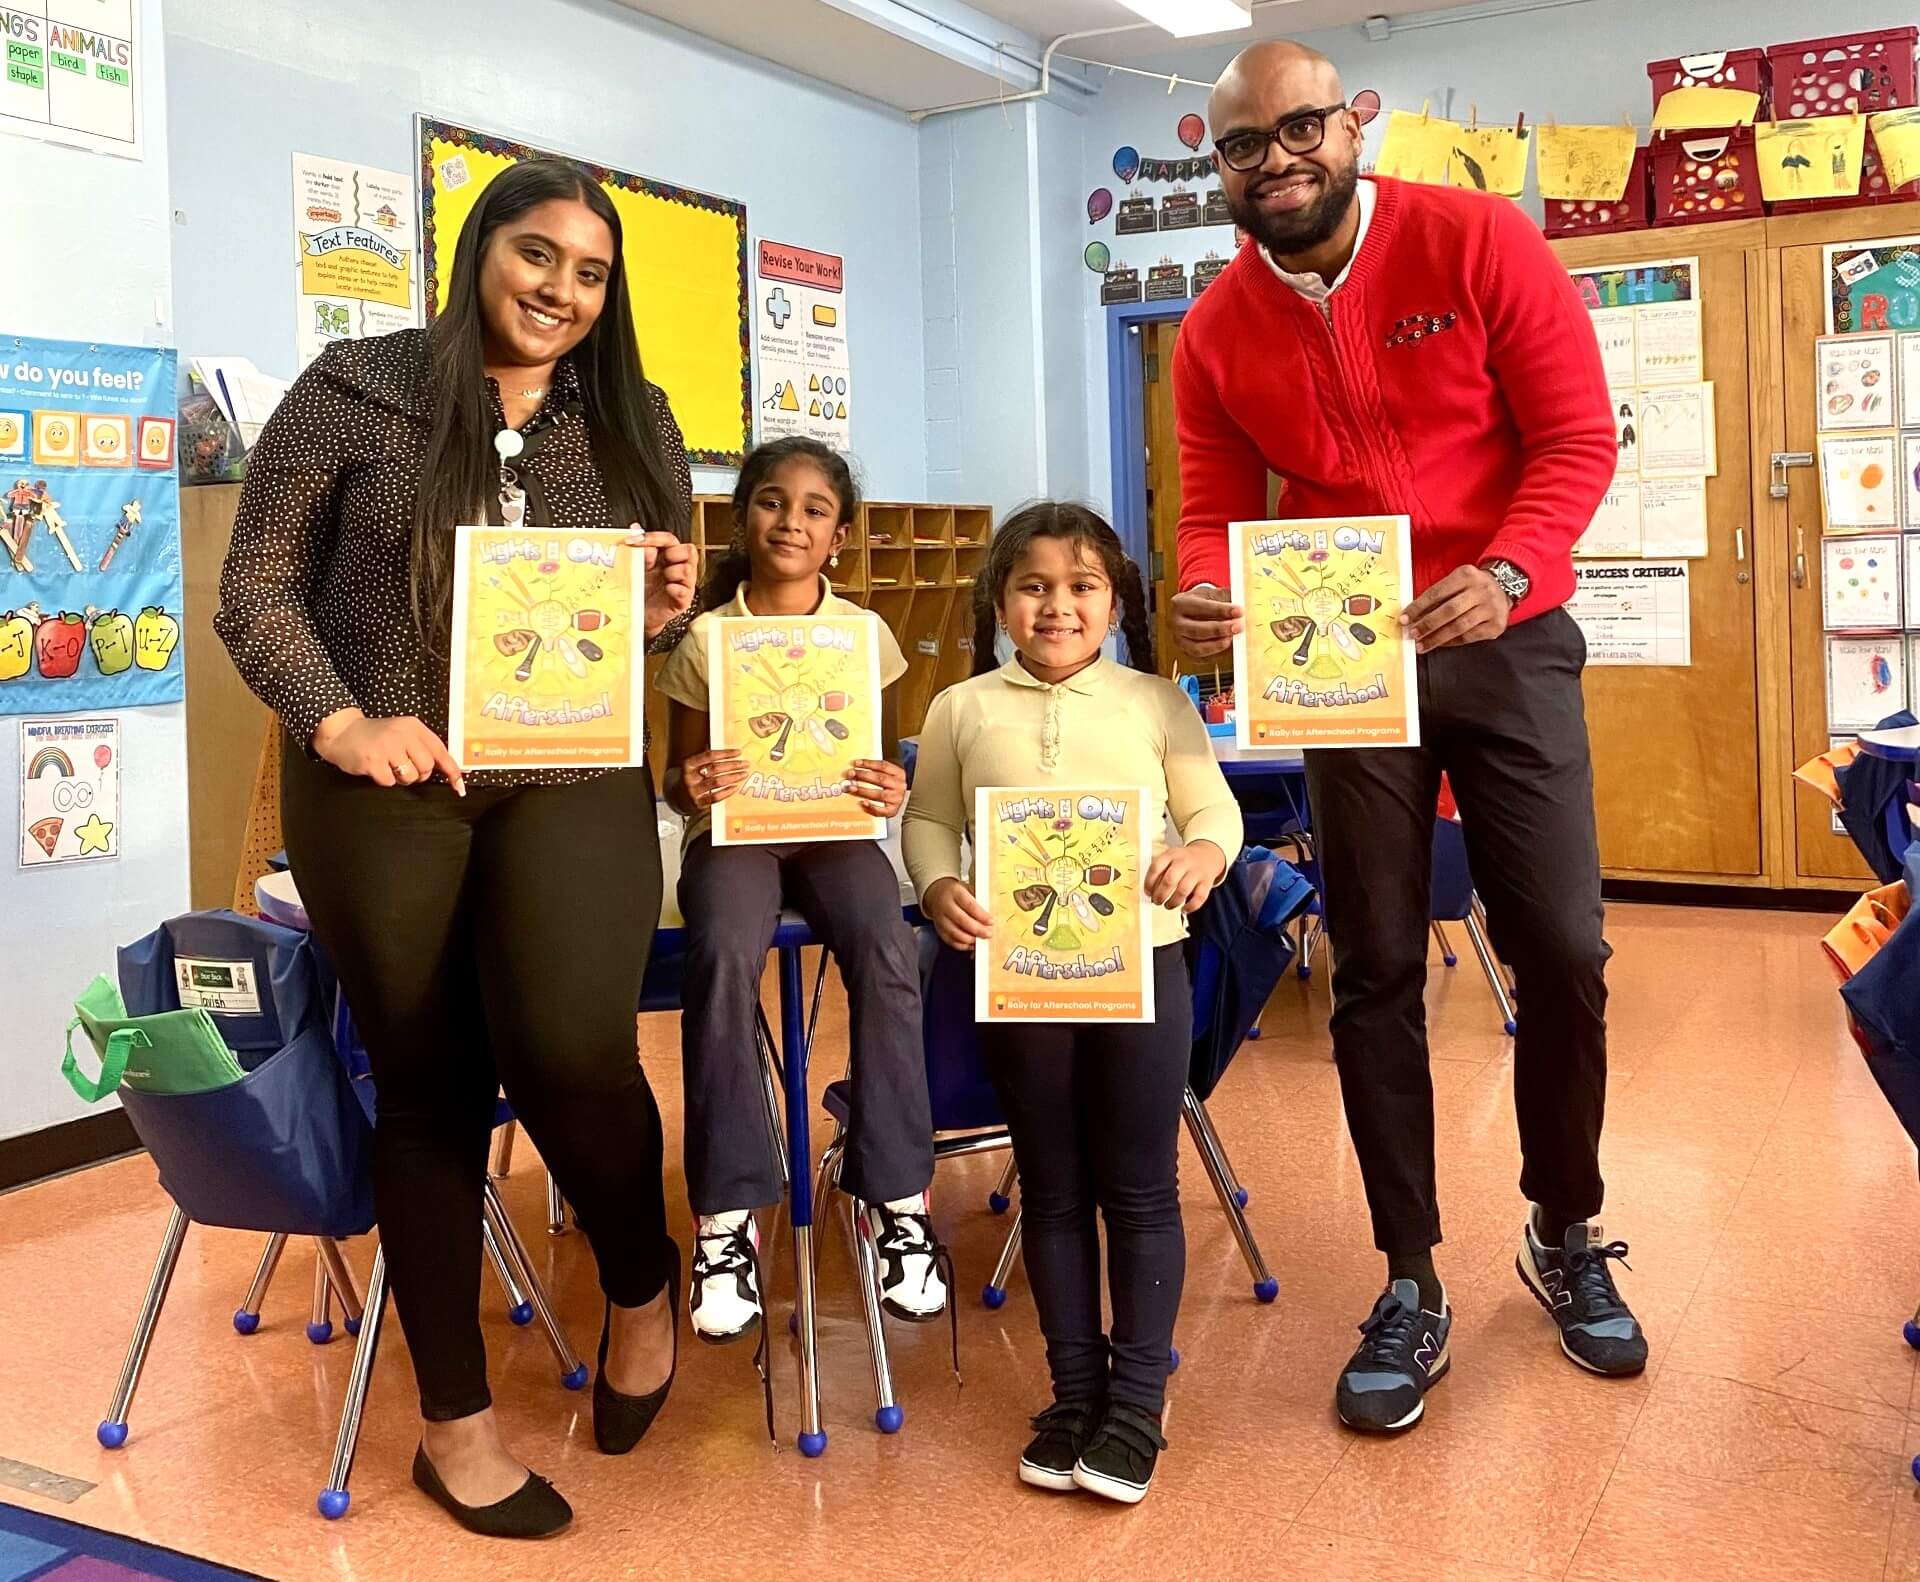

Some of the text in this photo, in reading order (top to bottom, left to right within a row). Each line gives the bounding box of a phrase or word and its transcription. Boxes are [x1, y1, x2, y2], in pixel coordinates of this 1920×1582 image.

[8, 44, 40, 61] paper
[50, 25, 129, 65] ANIMALS
[11, 67, 38, 83] staple
[58, 53, 79, 69] bird
[100, 66, 121, 81] fish
[313, 231, 399, 264] Text Features
[763, 251, 840, 280] Revise Your Work!
[1578, 271, 1655, 307] ATH
[14, 361, 43, 382] do
[48, 367, 89, 390] you
[93, 367, 144, 390] feel?
[479, 538, 617, 568] Lights ON
[1249, 526, 1385, 556] Lights ON
[1585, 569, 1629, 579] SUCCESS
[1632, 567, 1685, 578] CRITERIA
[41, 637, 79, 662] K-O
[96, 625, 128, 662] P-T
[139, 627, 173, 652] U-Z
[730, 624, 855, 652] Lights ON
[1263, 673, 1389, 707] Afterschool
[480, 692, 613, 725] Afterschool
[55, 725, 84, 735] BREATHING
[86, 724, 114, 733] EXERCISES
[1269, 727, 1400, 738] Rally for Afterschool Programs
[485, 747, 624, 757] Rally for Afterschool Programs
[740, 771, 858, 802] Afterschoo
[996, 795, 1127, 824] Lights ON
[745, 823, 765, 833] Rally
[780, 822, 829, 830] Afterschool
[1003, 945, 1125, 980] Afterschool
[1007, 1001, 1136, 1011] Rally for Afterschool Programs
